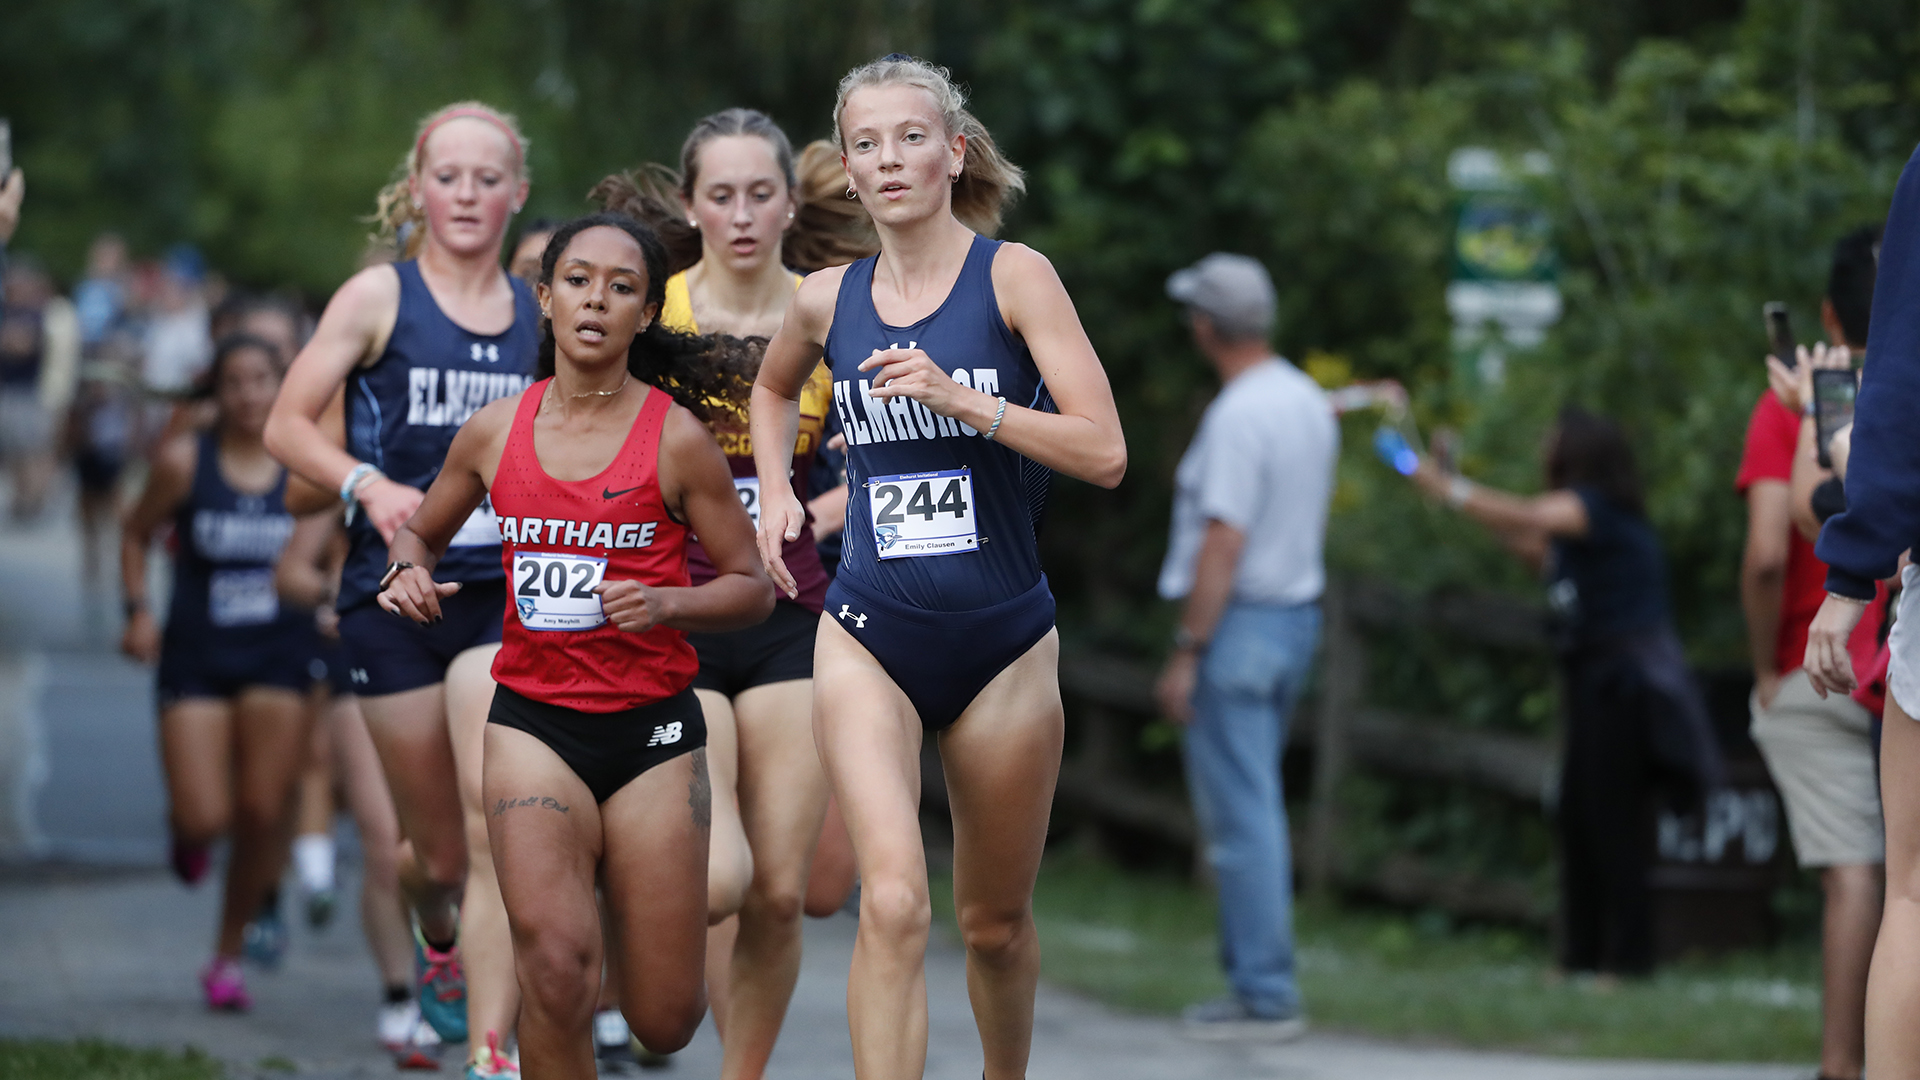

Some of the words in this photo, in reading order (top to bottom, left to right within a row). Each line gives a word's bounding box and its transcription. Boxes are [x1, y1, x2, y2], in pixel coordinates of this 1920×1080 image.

[875, 479, 967, 525] 244
[927, 541, 955, 549] Clausen
[518, 560, 595, 599] 202
